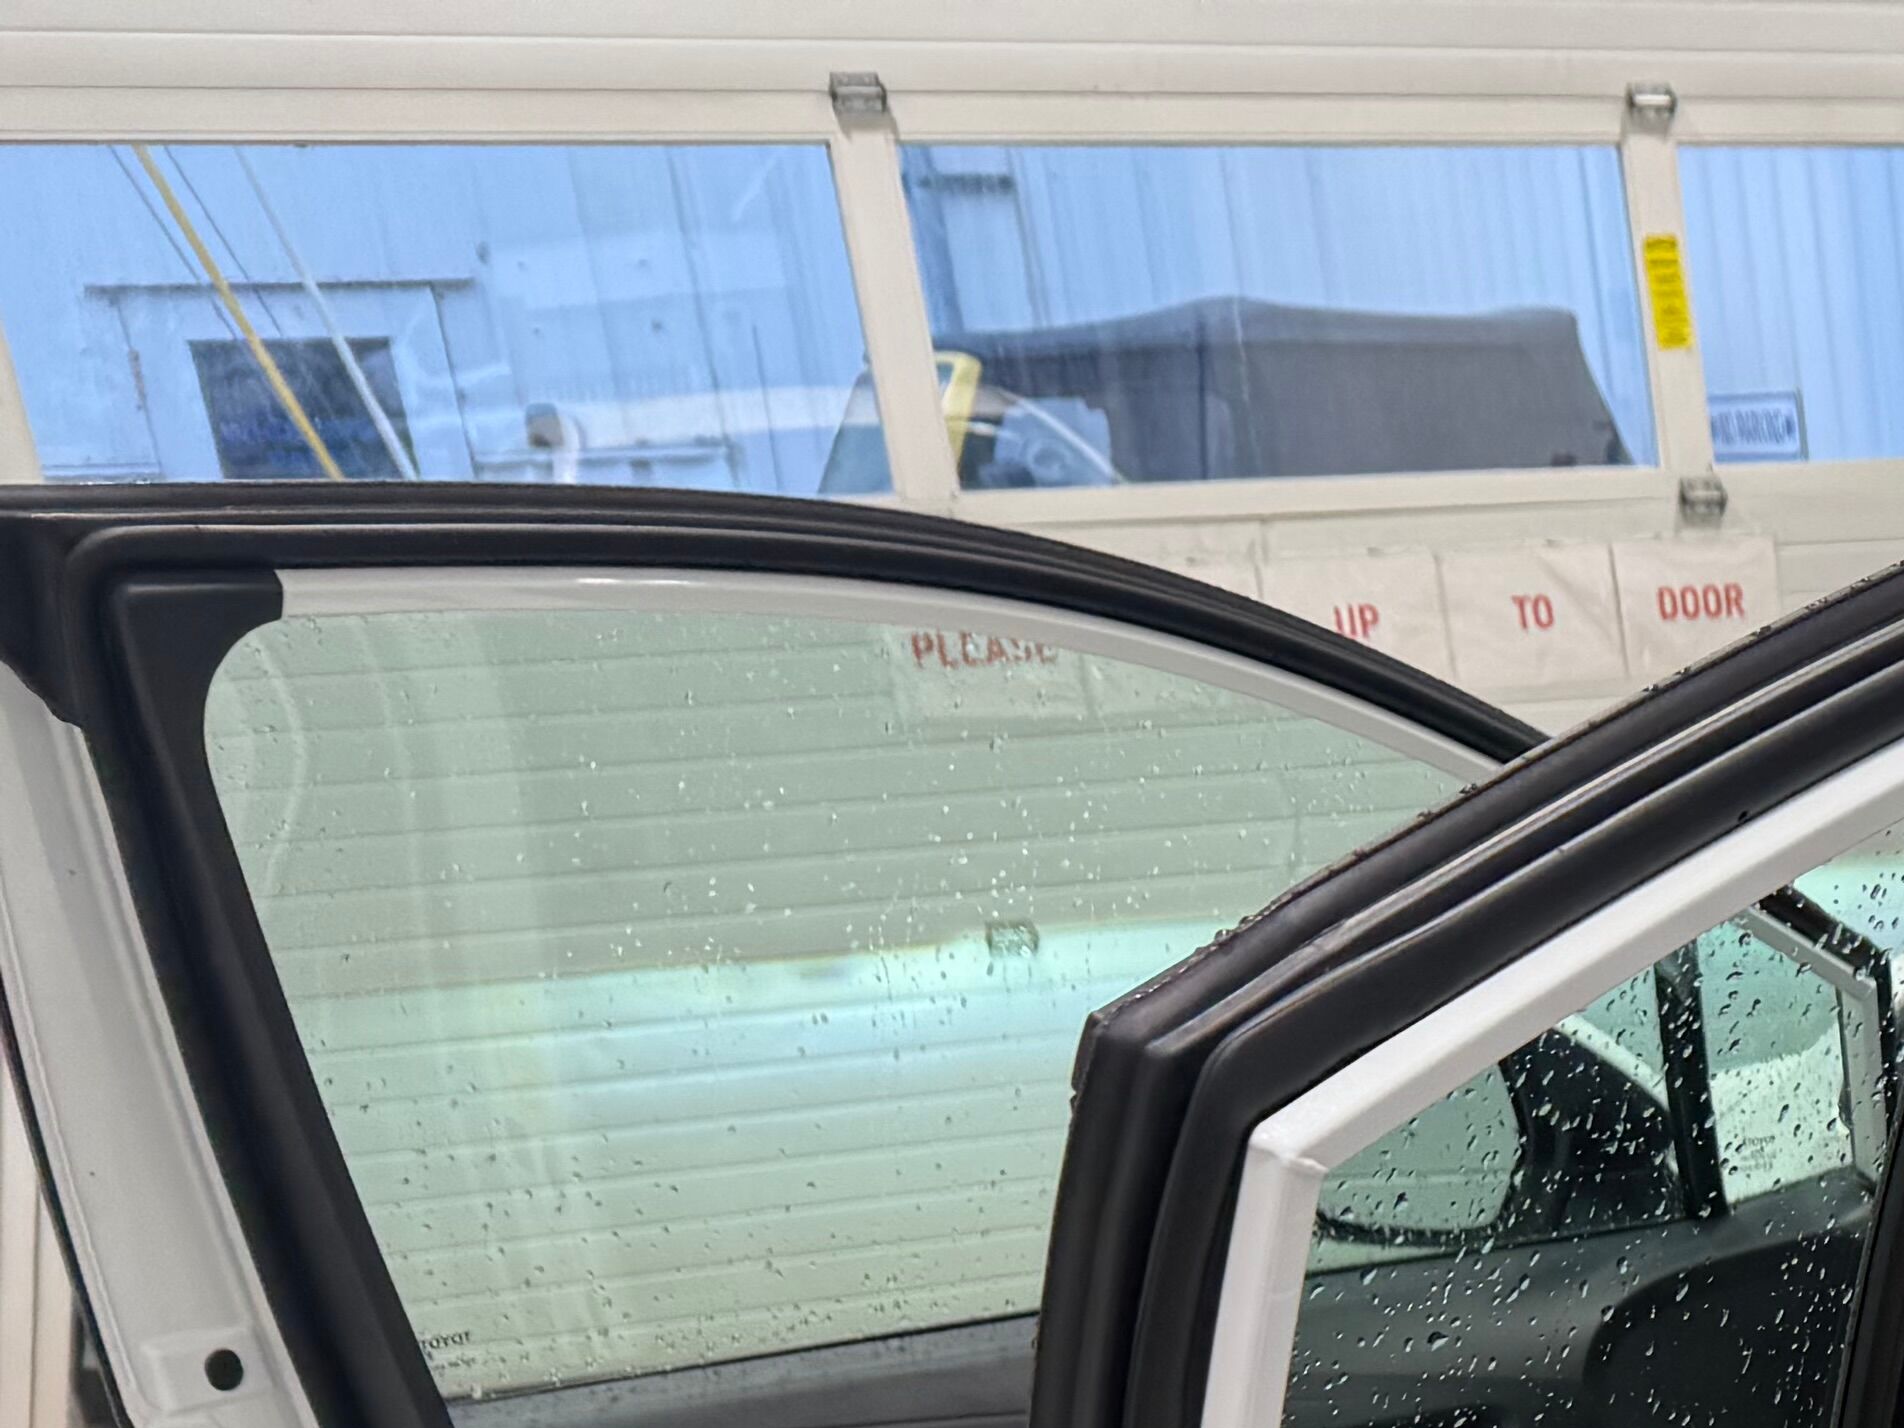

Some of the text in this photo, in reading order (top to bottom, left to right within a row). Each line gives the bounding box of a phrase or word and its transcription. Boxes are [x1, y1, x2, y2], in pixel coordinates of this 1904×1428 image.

[1334, 604, 1379, 638] UP
[1512, 594, 1555, 630] TO
[1656, 583, 1745, 621] DOOR
